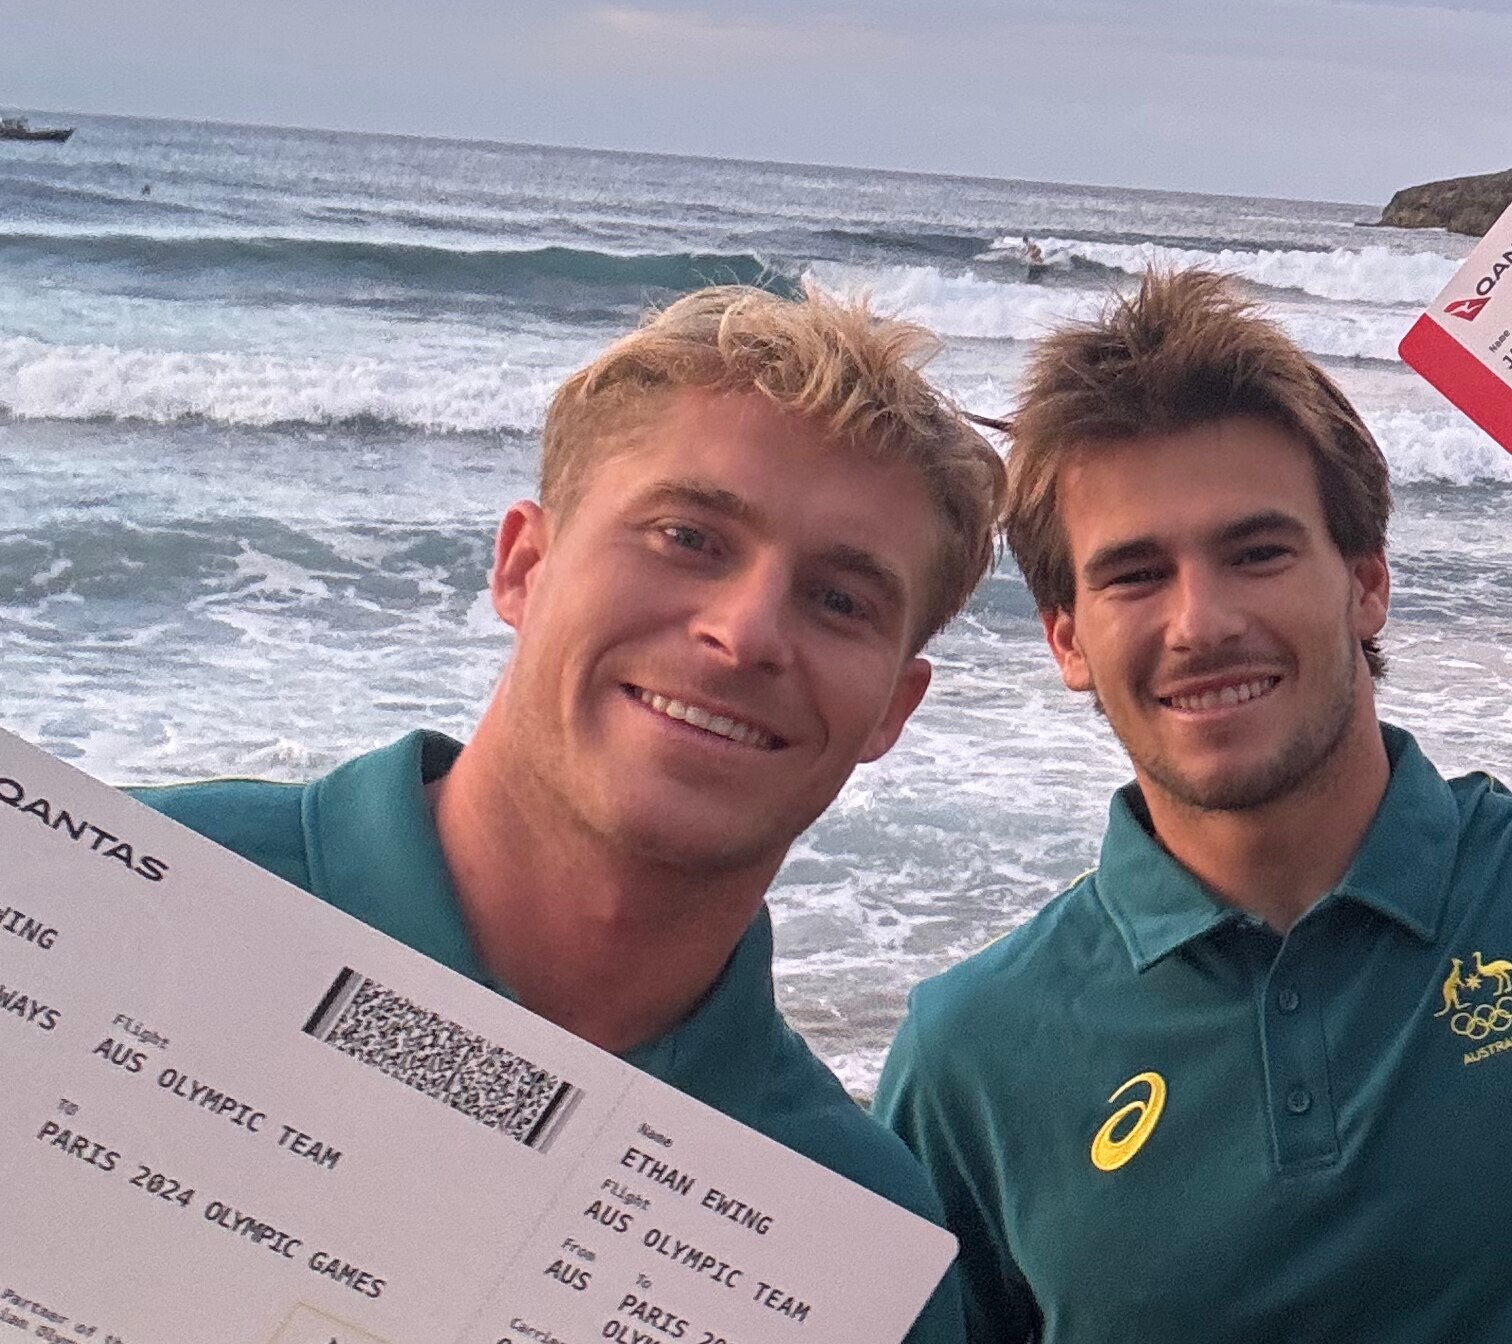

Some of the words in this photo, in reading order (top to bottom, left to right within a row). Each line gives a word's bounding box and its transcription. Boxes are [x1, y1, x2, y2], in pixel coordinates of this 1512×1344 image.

[1488, 329, 1511, 354] Name
[0, 777, 169, 882] QANTAS
[110, 1013, 170, 1050] Flight
[91, 1037, 149, 1074] AUS
[157, 1068, 267, 1133] OLYMPIC
[277, 1124, 343, 1170] TEAM
[636, 1122, 674, 1148] Name
[36, 1120, 122, 1172] PARIS
[128, 1164, 196, 1208] 2024
[203, 1200, 304, 1260] OLYMPIC
[307, 1251, 387, 1299] GAMES
[600, 1178, 652, 1211] Flight
[620, 1147, 696, 1197] ETHAN
[700, 1187, 774, 1236] EWING
[560, 1237, 597, 1263] From
[583, 1199, 634, 1234] AUS
[643, 1228, 744, 1289] OLYMPIC
[752, 1281, 812, 1323] TEAM
[543, 1259, 593, 1292] AUS
[635, 1272, 653, 1290] To
[617, 1293, 690, 1339] PARIS
